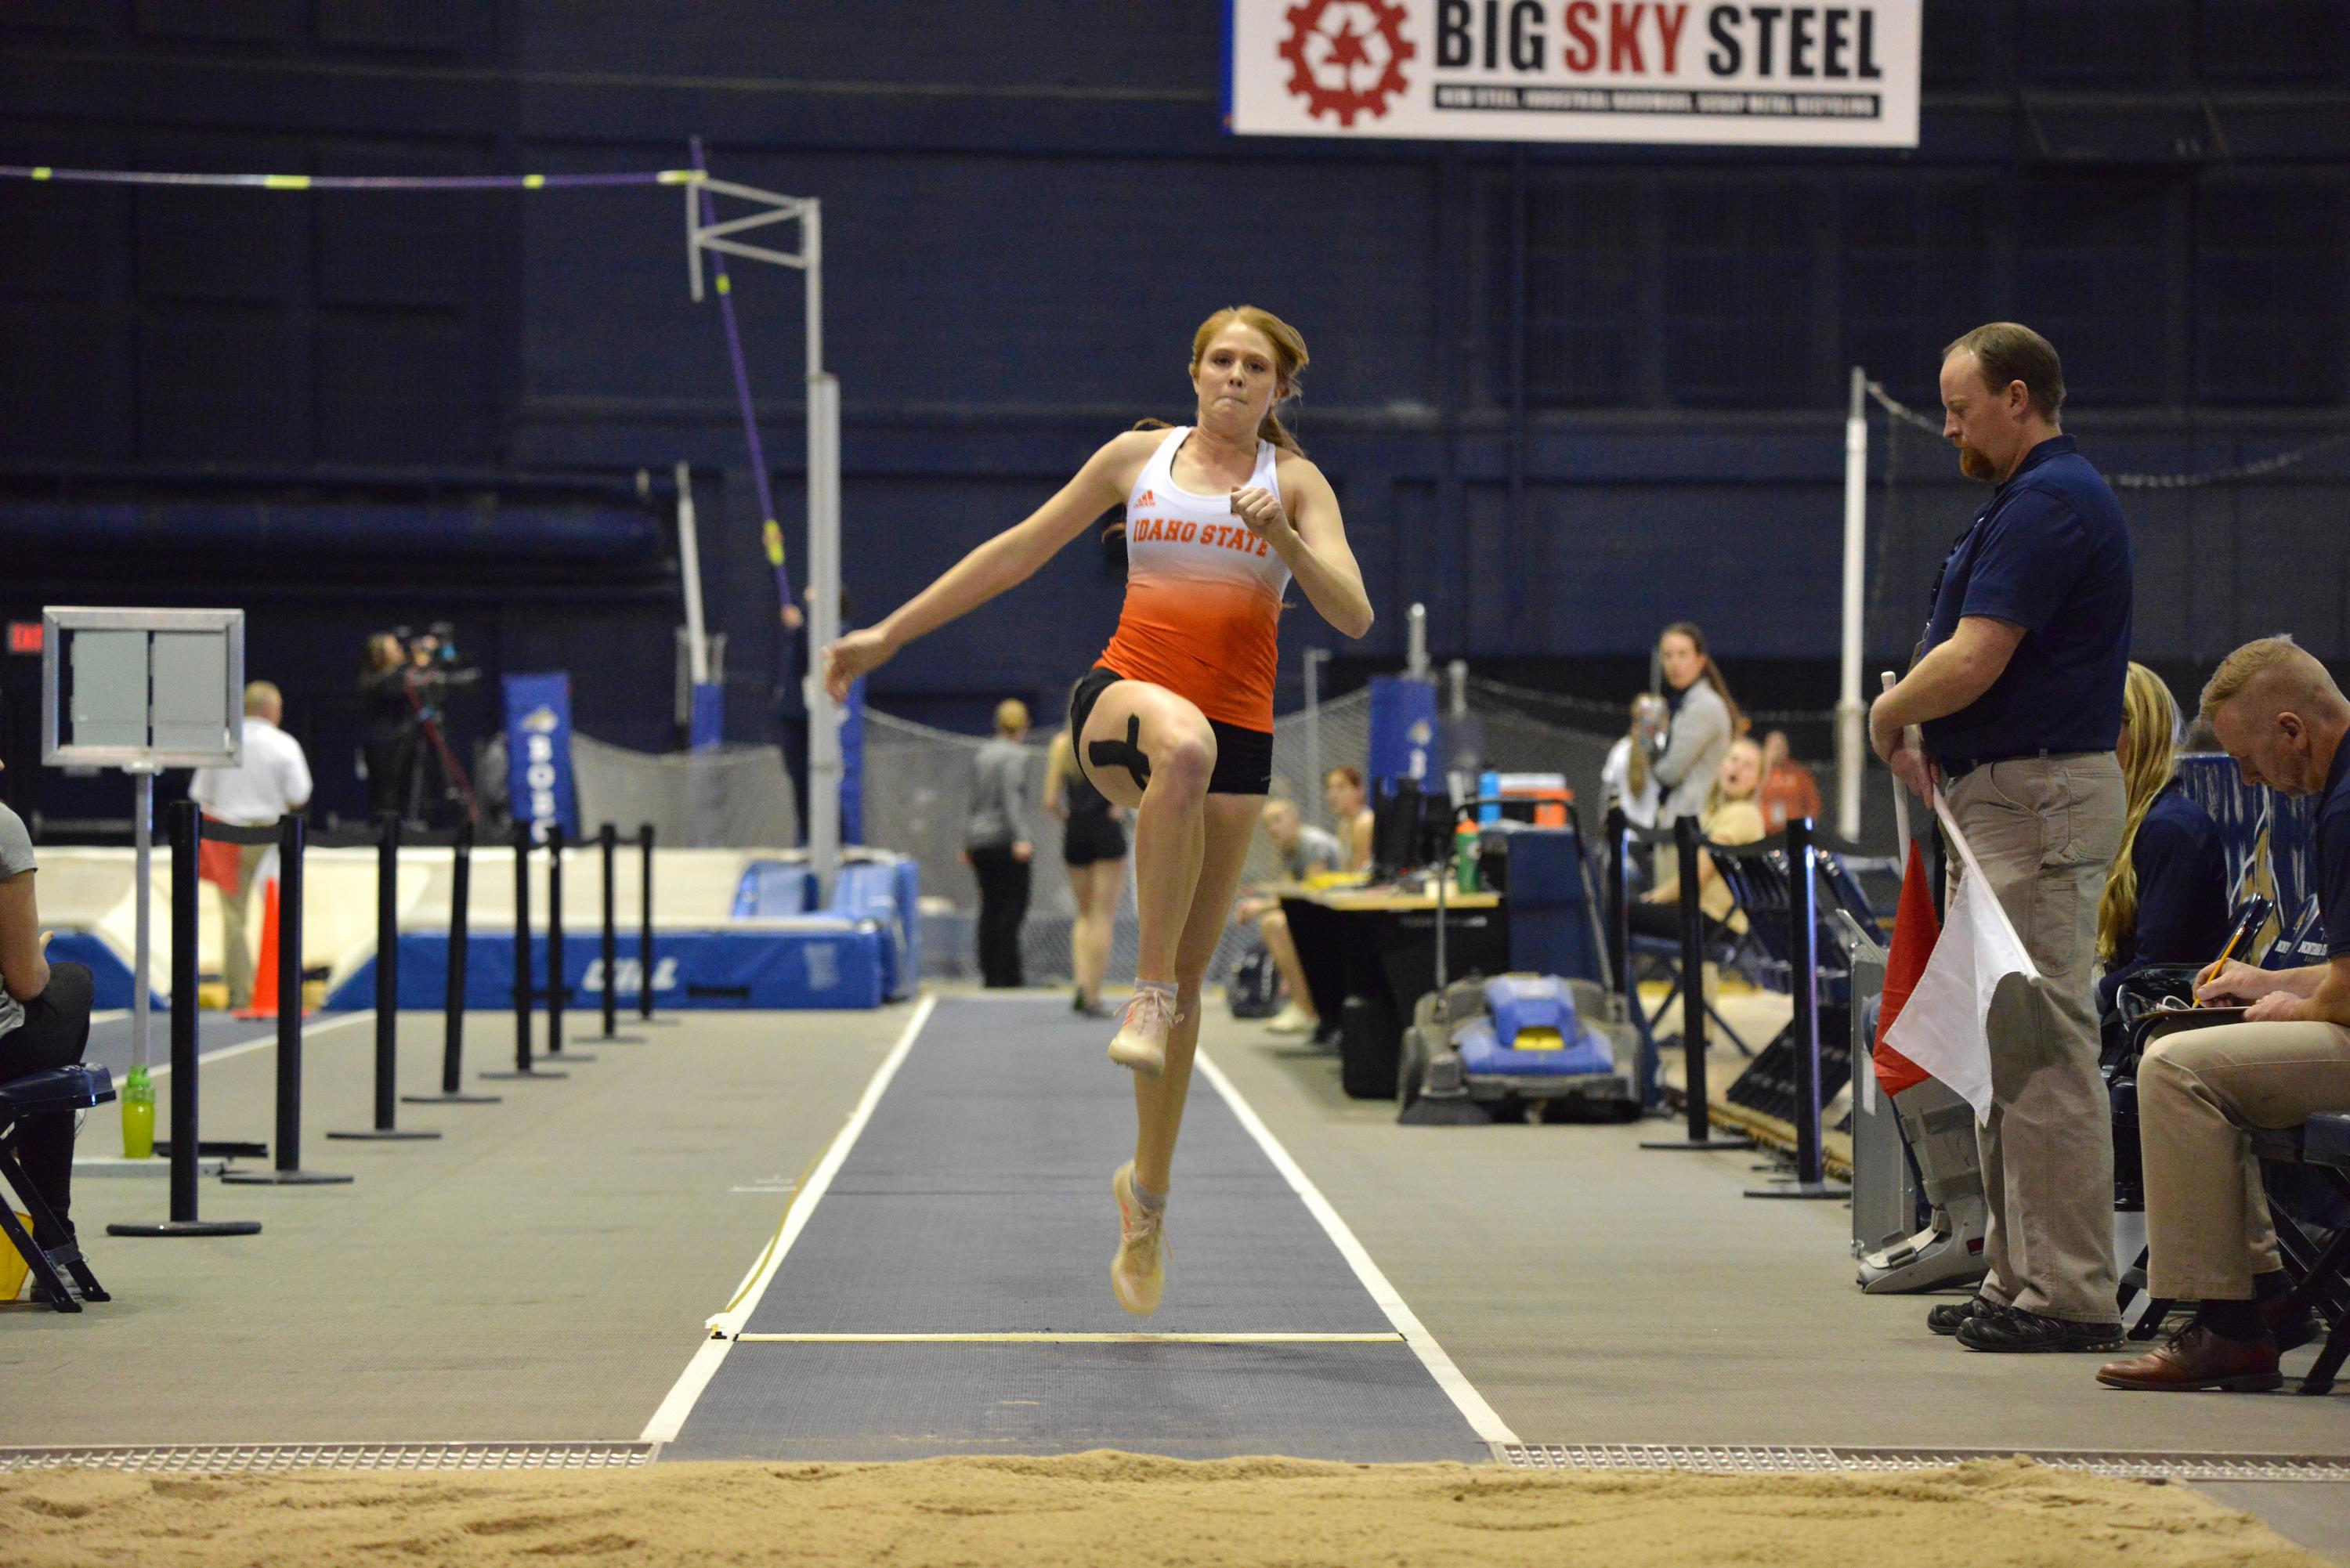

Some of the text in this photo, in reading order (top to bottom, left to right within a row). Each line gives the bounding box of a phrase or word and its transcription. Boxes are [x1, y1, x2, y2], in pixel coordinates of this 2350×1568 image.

[1435, 0, 1882, 78] BIG SKY STEEL
[1133, 518, 1268, 557] IDAHO STATE
